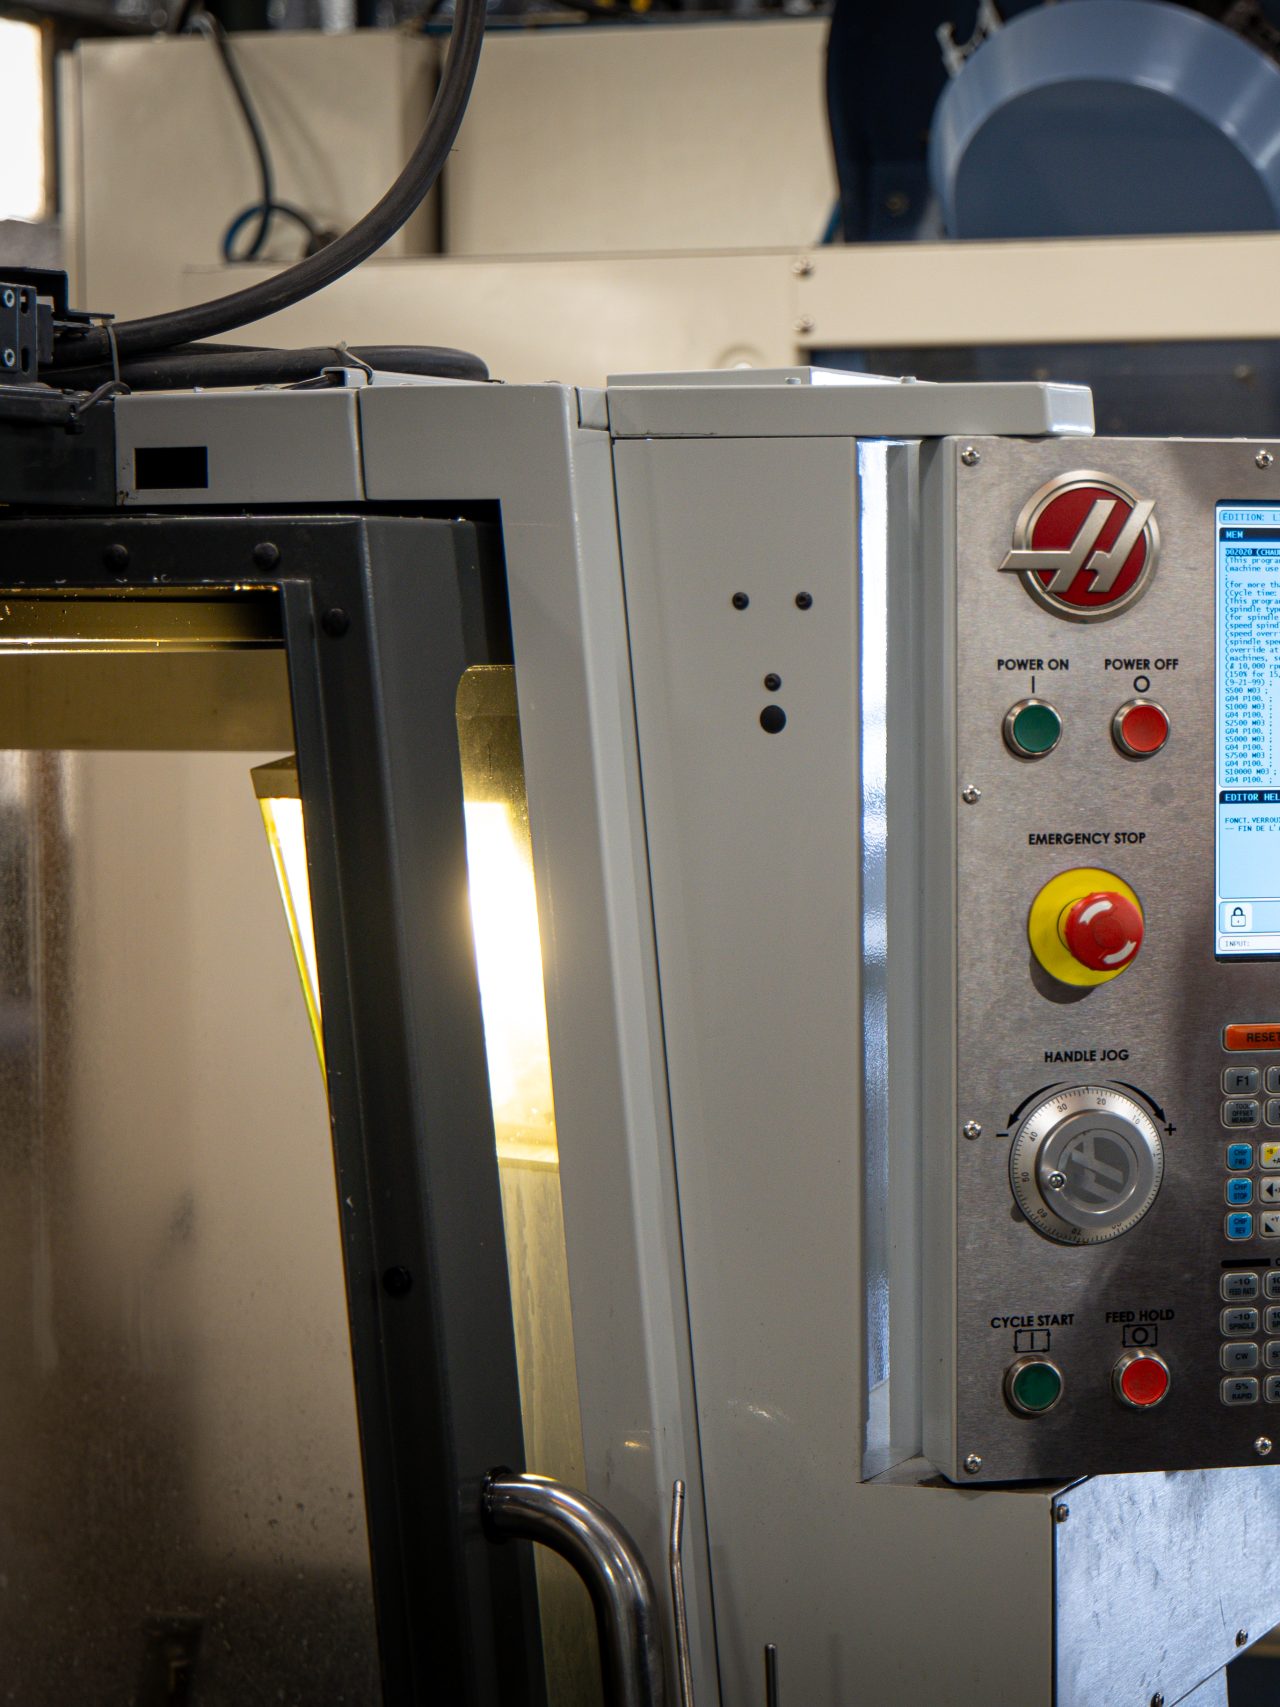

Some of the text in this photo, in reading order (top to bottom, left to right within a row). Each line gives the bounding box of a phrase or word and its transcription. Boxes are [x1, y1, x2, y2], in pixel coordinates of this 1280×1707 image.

[997, 659, 1069, 670] POWER ON
[1105, 658, 1178, 670] POWER OFF
[1029, 832, 1145, 844] EMERGENCY STOP
[1045, 1050, 1129, 1062] HANDLE JOG
[1236, 1076, 1249, 1086] F1
[1096, 1097, 1106, 1105] 20
[1057, 1103, 1068, 1113] 30
[1029, 1131, 1038, 1142] 40
[991, 1314, 1074, 1328] CYCLE START
[1106, 1309, 1174, 1323] FEED HOLD
